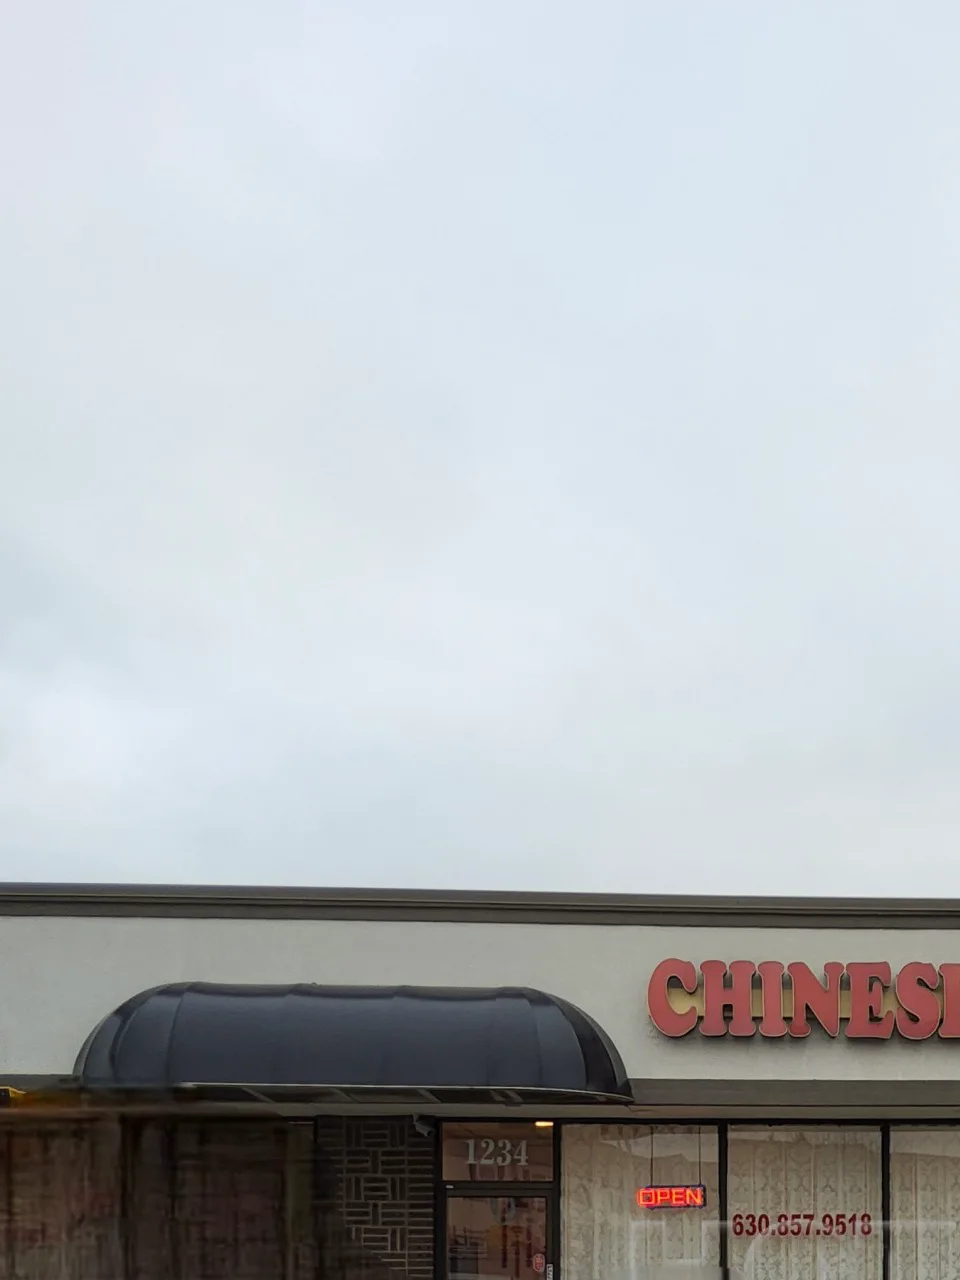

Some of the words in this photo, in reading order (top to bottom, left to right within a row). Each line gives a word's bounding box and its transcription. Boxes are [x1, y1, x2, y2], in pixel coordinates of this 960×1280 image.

[465, 1138, 529, 1166] 1234
[637, 1186, 705, 1208] OPEN
[731, 1212, 873, 1237] 630.857.9518
